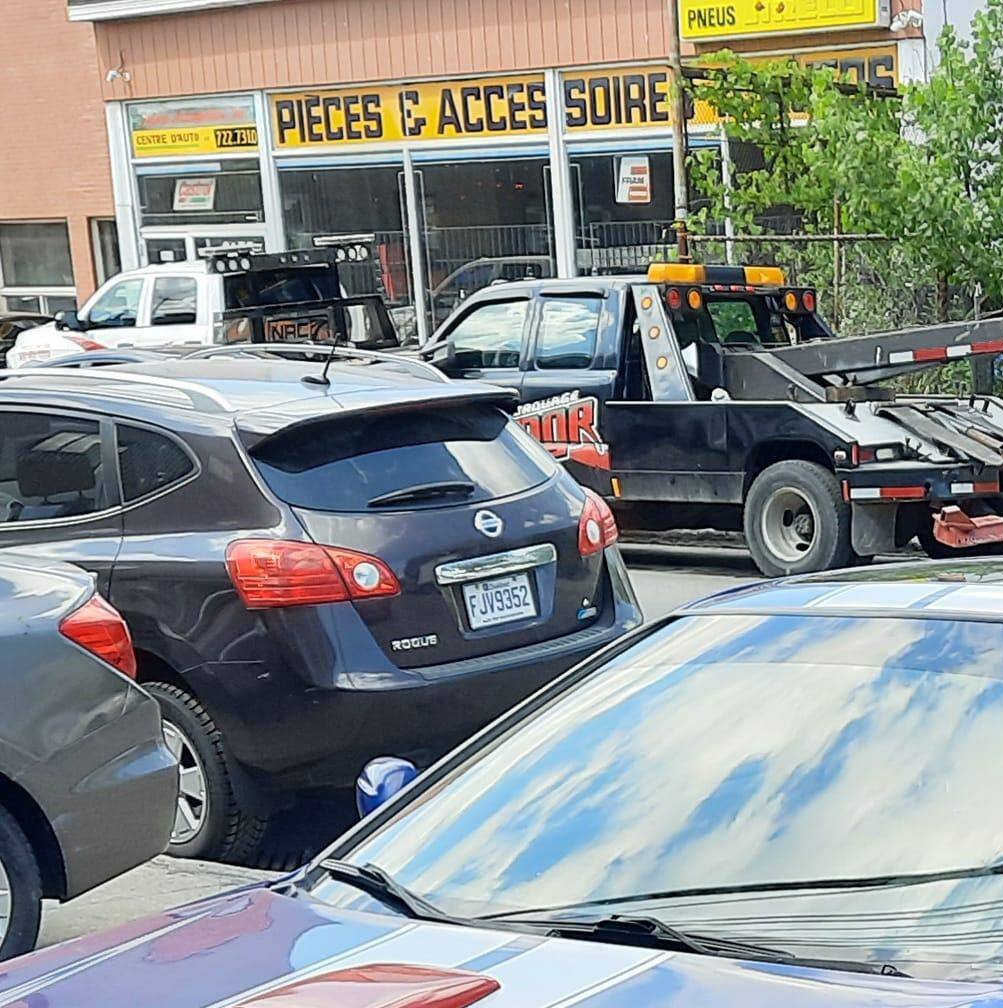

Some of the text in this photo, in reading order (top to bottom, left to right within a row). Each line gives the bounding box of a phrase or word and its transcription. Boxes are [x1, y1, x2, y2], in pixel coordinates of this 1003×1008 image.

[687, 5, 736, 30] PNEUS
[136, 133, 168, 146] CENTRE
[468, 584, 531, 618] FJV9352
[391, 634, 438, 651] ROGUE
